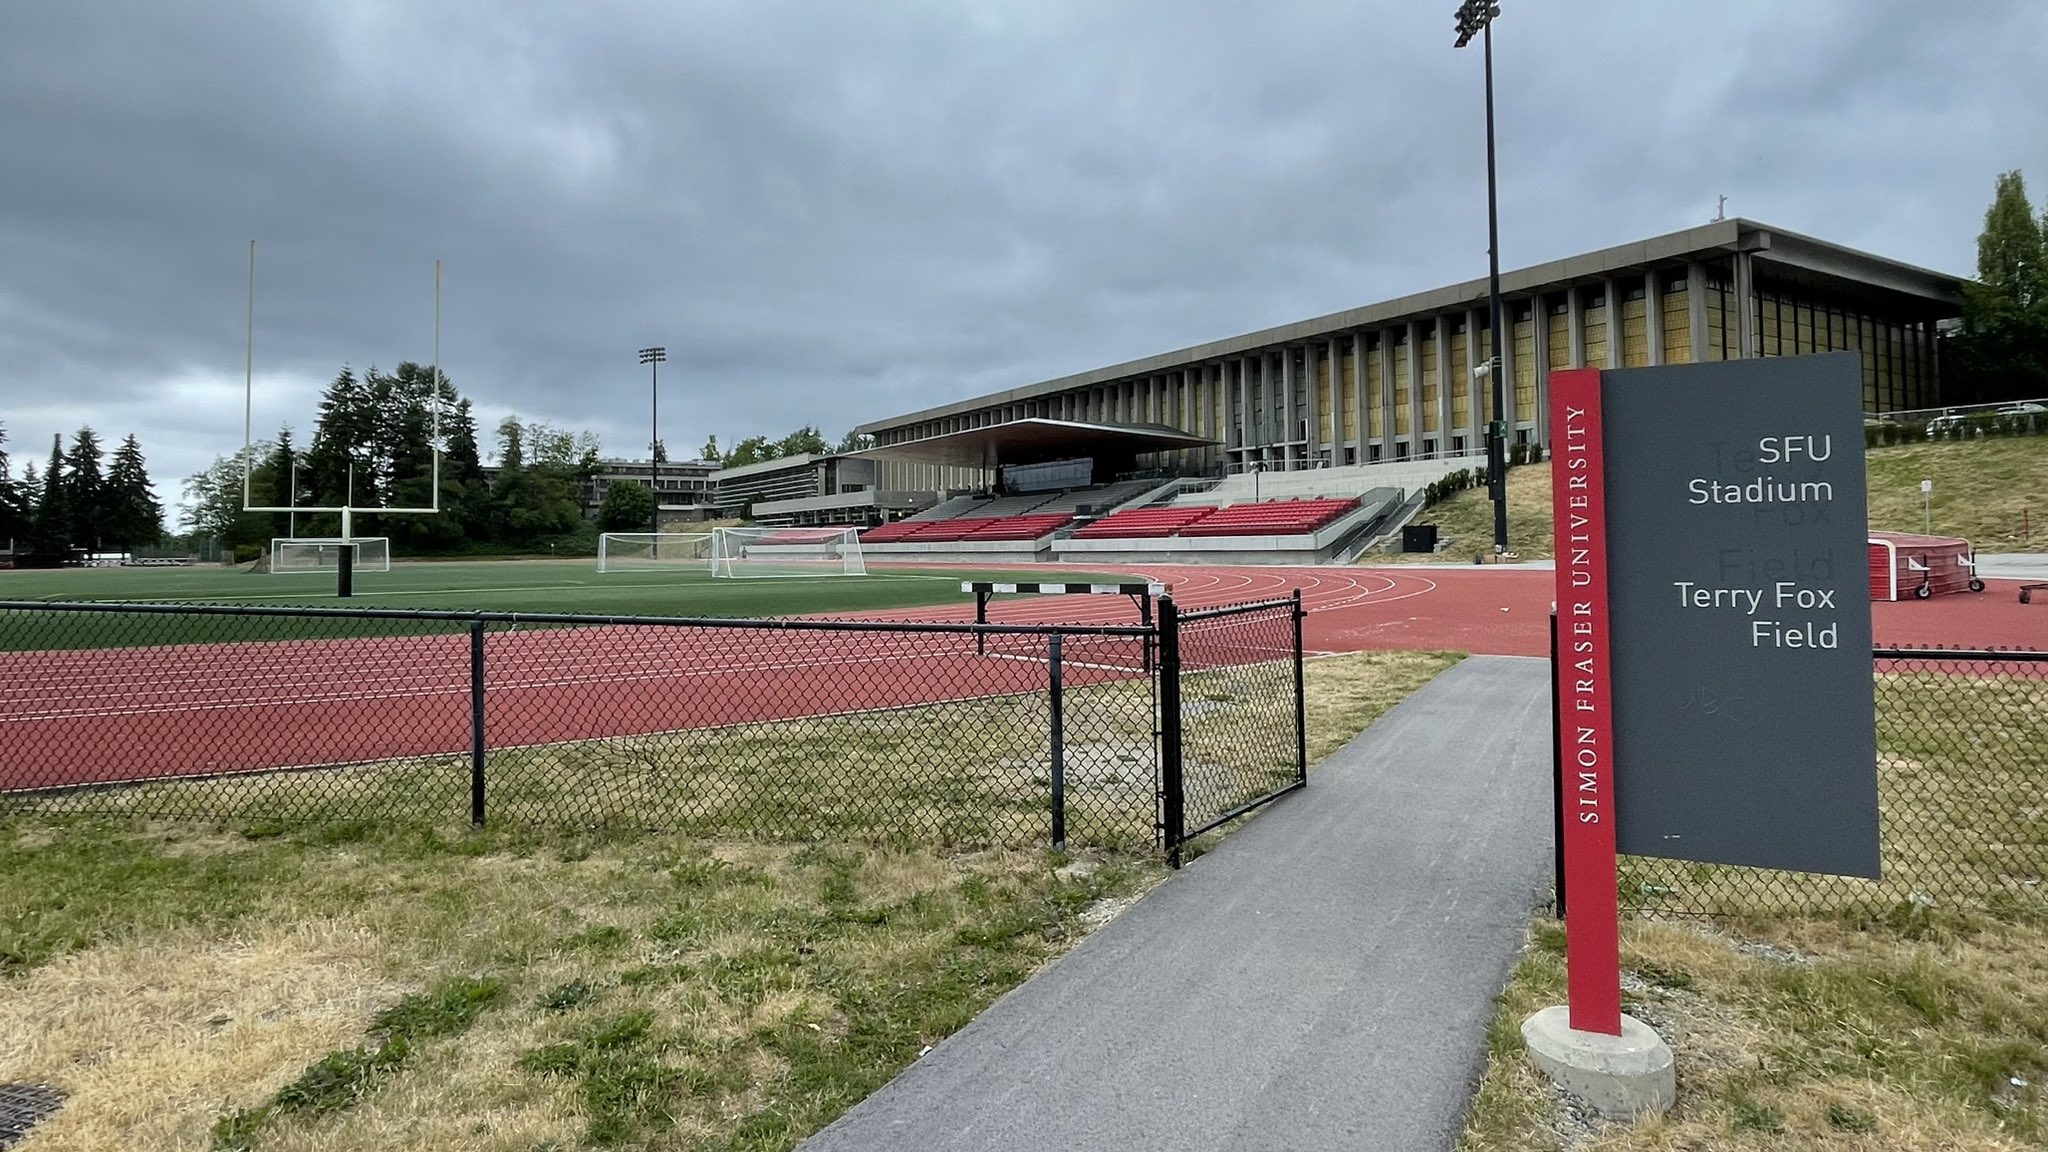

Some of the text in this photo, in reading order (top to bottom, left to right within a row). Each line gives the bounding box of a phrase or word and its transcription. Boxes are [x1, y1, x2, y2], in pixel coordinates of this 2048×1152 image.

[1758, 434, 1831, 464] SFU
[1688, 476, 1833, 504] Stadium
[1673, 581, 1836, 615] Terry Fox
[1566, 406, 1599, 824] SIMON FRASER UNIVERSITY
[1752, 620, 1838, 649] Field
